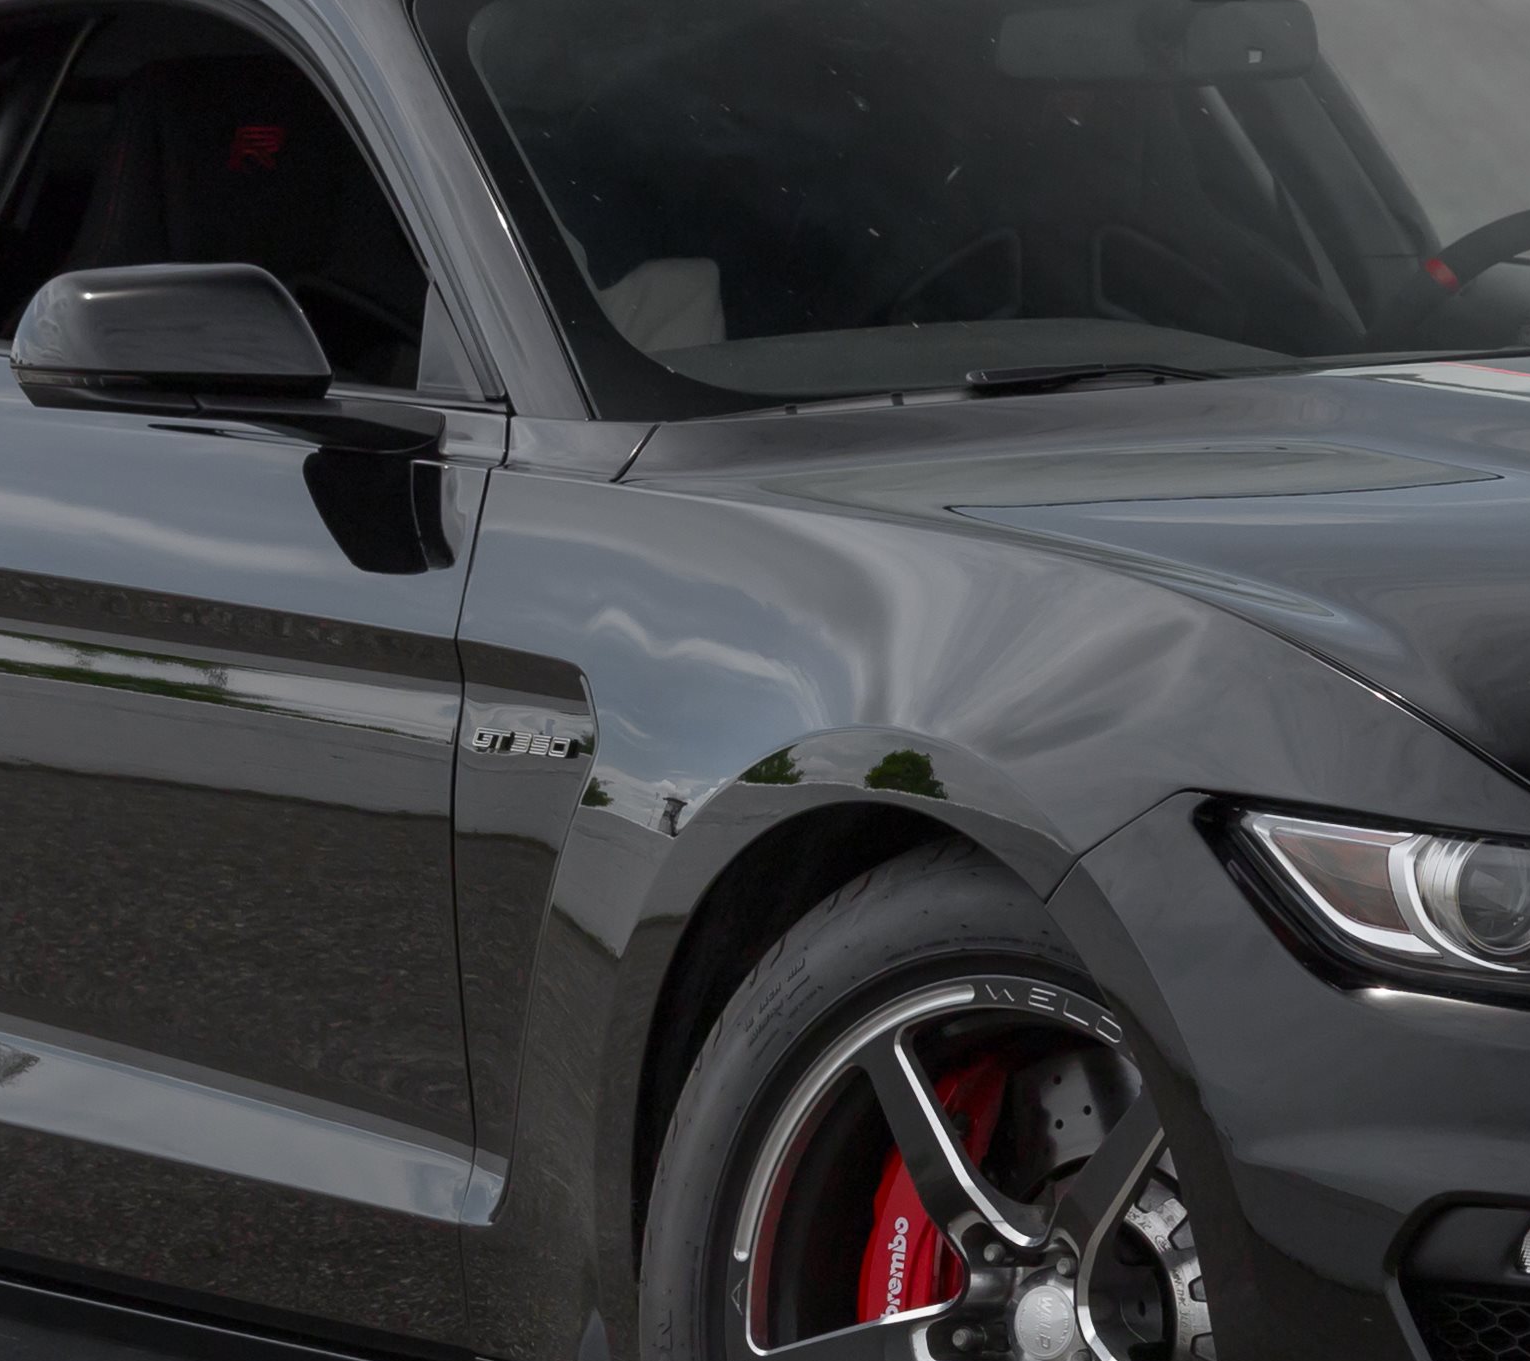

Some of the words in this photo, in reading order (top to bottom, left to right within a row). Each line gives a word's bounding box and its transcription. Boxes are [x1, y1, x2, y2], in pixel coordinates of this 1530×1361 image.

[472, 726, 572, 758] GT350
[984, 981, 1123, 1045] WELD
[879, 1215, 910, 1319] brembo
